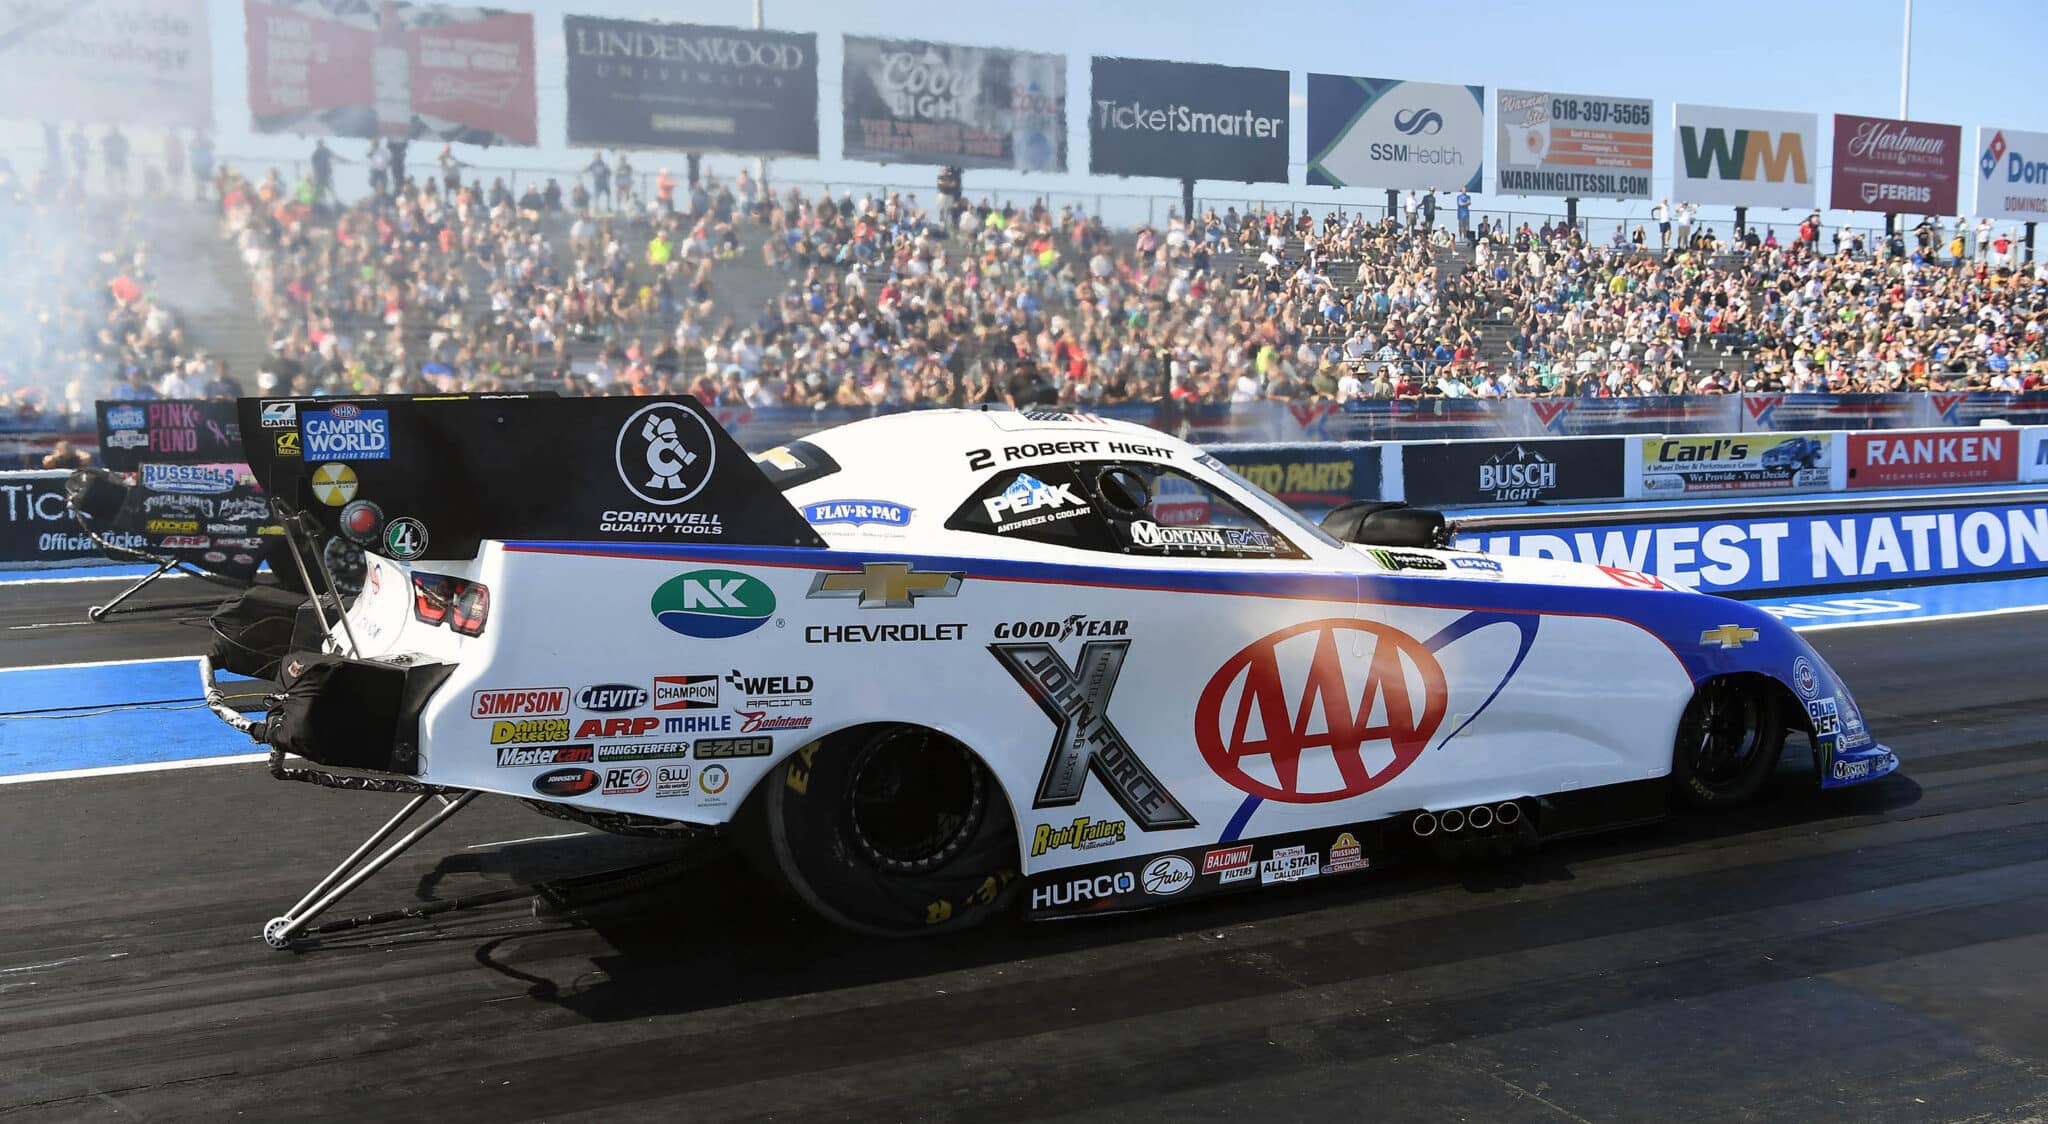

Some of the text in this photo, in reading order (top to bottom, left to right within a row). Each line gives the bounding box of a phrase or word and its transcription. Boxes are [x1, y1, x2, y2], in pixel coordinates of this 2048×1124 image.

[577, 31, 803, 70] LINDENWOOD
[1097, 101, 1280, 138] TicketSmarter
[1552, 98, 1650, 126] 618-397-5565
[1849, 122, 1945, 159] Hartmann
[1680, 126, 1808, 184] WM
[1500, 170, 1648, 195] WARNINGLITESSIL.COM
[1879, 184, 1931, 202] FERRIS
[150, 404, 195, 428] PINK
[332, 406, 357, 417] NHRA
[306, 420, 385, 435] CAMPING
[150, 428, 198, 452] FUND
[308, 434, 386, 451] WORLD
[1659, 440, 1748, 463] Carl's
[1866, 437, 2001, 466] RANKEN
[965, 441, 1175, 471] 2 ROBERT HIGHT
[144, 465, 234, 486] RUSSELLS
[1285, 461, 1354, 493] PARTS
[1480, 463, 1556, 491] BUSCH
[1689, 473, 1703, 482] We
[1704, 472, 1736, 481] Provide
[1744, 471, 1762, 480] You
[1762, 470, 1790, 479] Decide
[1880, 470, 1988, 481] TECHNICAL COLLEGE
[982, 483, 1088, 523] PEAK
[1496, 488, 1541, 501] LIGHT
[600, 523, 722, 535] QUALITY TOOLS
[602, 511, 722, 525] CORNWELL
[997, 515, 1048, 534] ANTIFREEZE
[1055, 507, 1091, 520] COOLANT
[1131, 520, 1224, 546] MONTANA
[684, 579, 748, 609] NK
[805, 624, 968, 643] CHEVROLET
[478, 685, 647, 714] SIMPSON CLEVITE
[657, 676, 814, 699] CHAMPION WELD
[746, 698, 812, 708] RACING
[1215, 620, 1428, 800] AAA
[1810, 701, 1836, 717] Blue
[491, 719, 568, 744] DARTON
[574, 717, 659, 737] ARP
[665, 715, 731, 733] MAHLE
[514, 730, 568, 743] SLEEVES
[1024, 656, 1166, 814] JOHN FORCE
[499, 738, 770, 765] Mastercam HANGSTERFER'S EZGO
[1079, 838, 1115, 851] Nationwide
[1332, 847, 1360, 858] mission
[1207, 851, 1248, 869] BALDWIN
[1225, 866, 1252, 879] FILTERS
[1274, 868, 1306, 880] CALLOUT
[1032, 871, 1135, 910] HURCO
[1145, 861, 1189, 889] Gates
